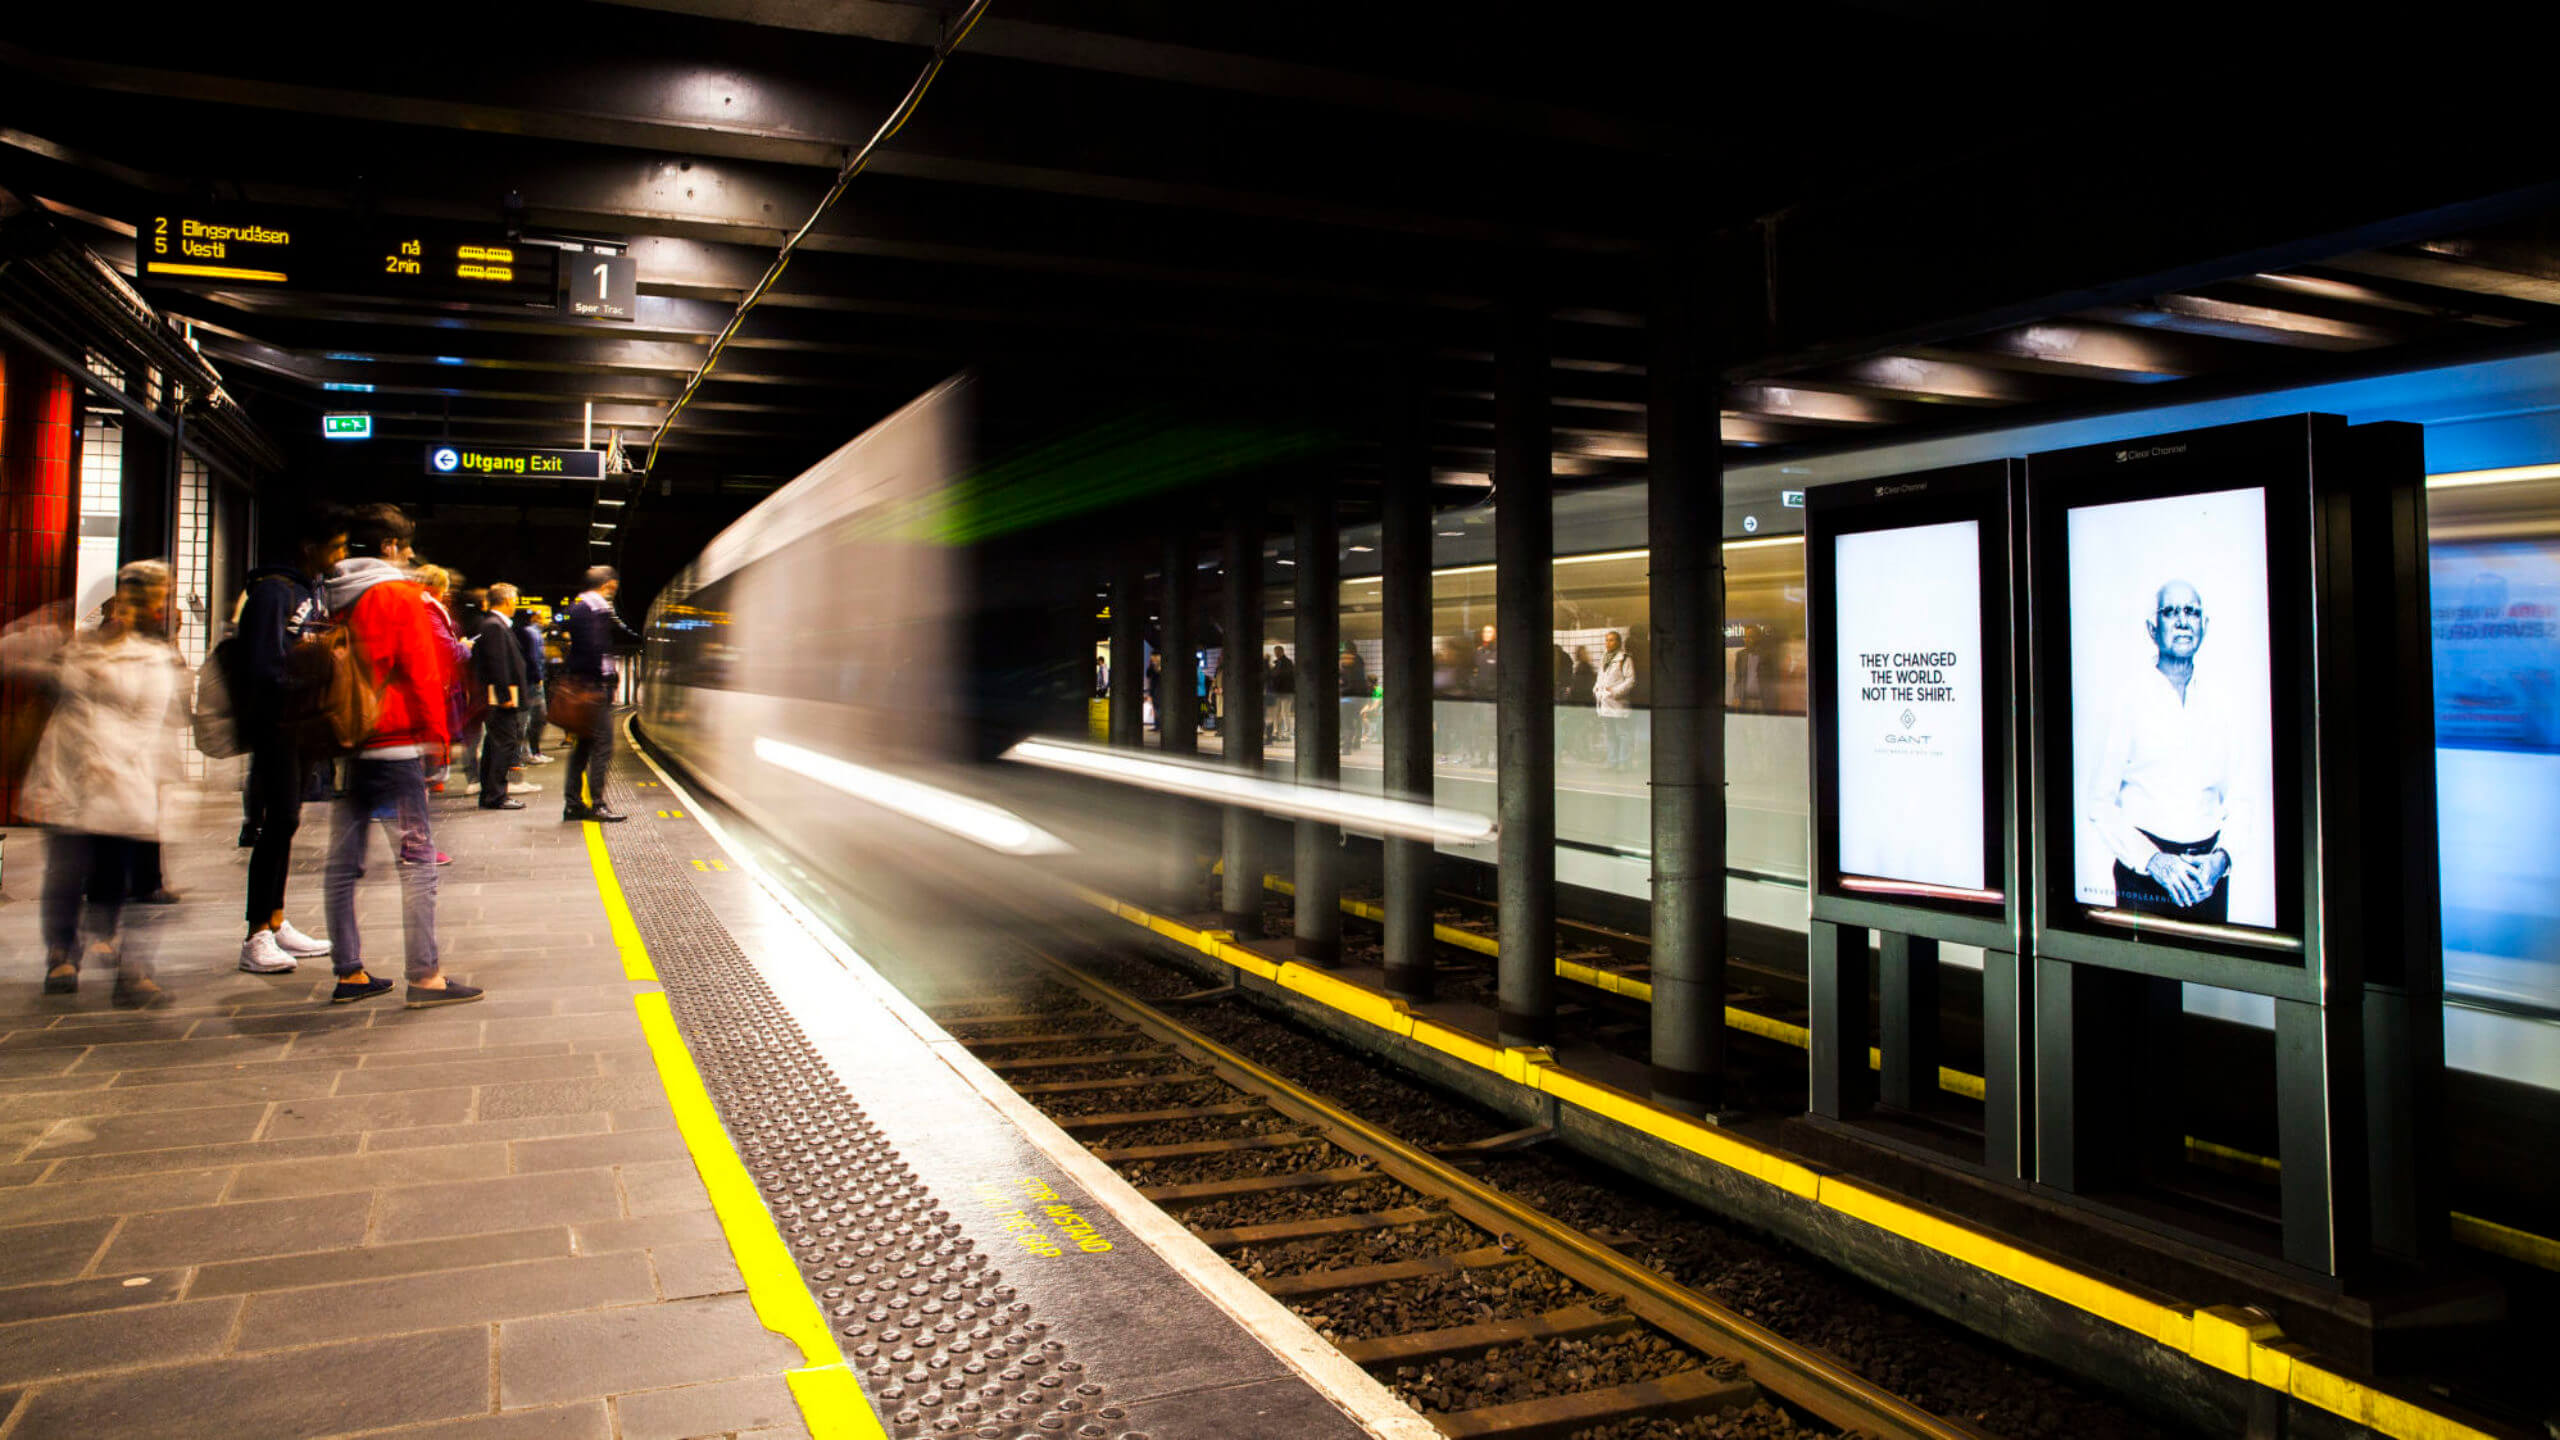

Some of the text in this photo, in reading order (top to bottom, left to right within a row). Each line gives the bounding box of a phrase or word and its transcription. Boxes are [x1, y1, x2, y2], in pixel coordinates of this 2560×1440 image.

[154, 216, 168, 235] 2
[401, 239, 421, 256] nå
[154, 236, 421, 275] 5 Vestli 2min
[593, 263, 609, 300] 1
[575, 302, 599, 315] Spor
[462, 452, 563, 474] Utgang Exit
[1859, 651, 1957, 668] THEY CHANGED
[1870, 669, 1946, 684] THE WORLD.
[1861, 686, 1956, 702] NOT THE SHIRT.
[1884, 734, 1932, 744] GANT
[1040, 1203, 1113, 1253] AVSTAND
